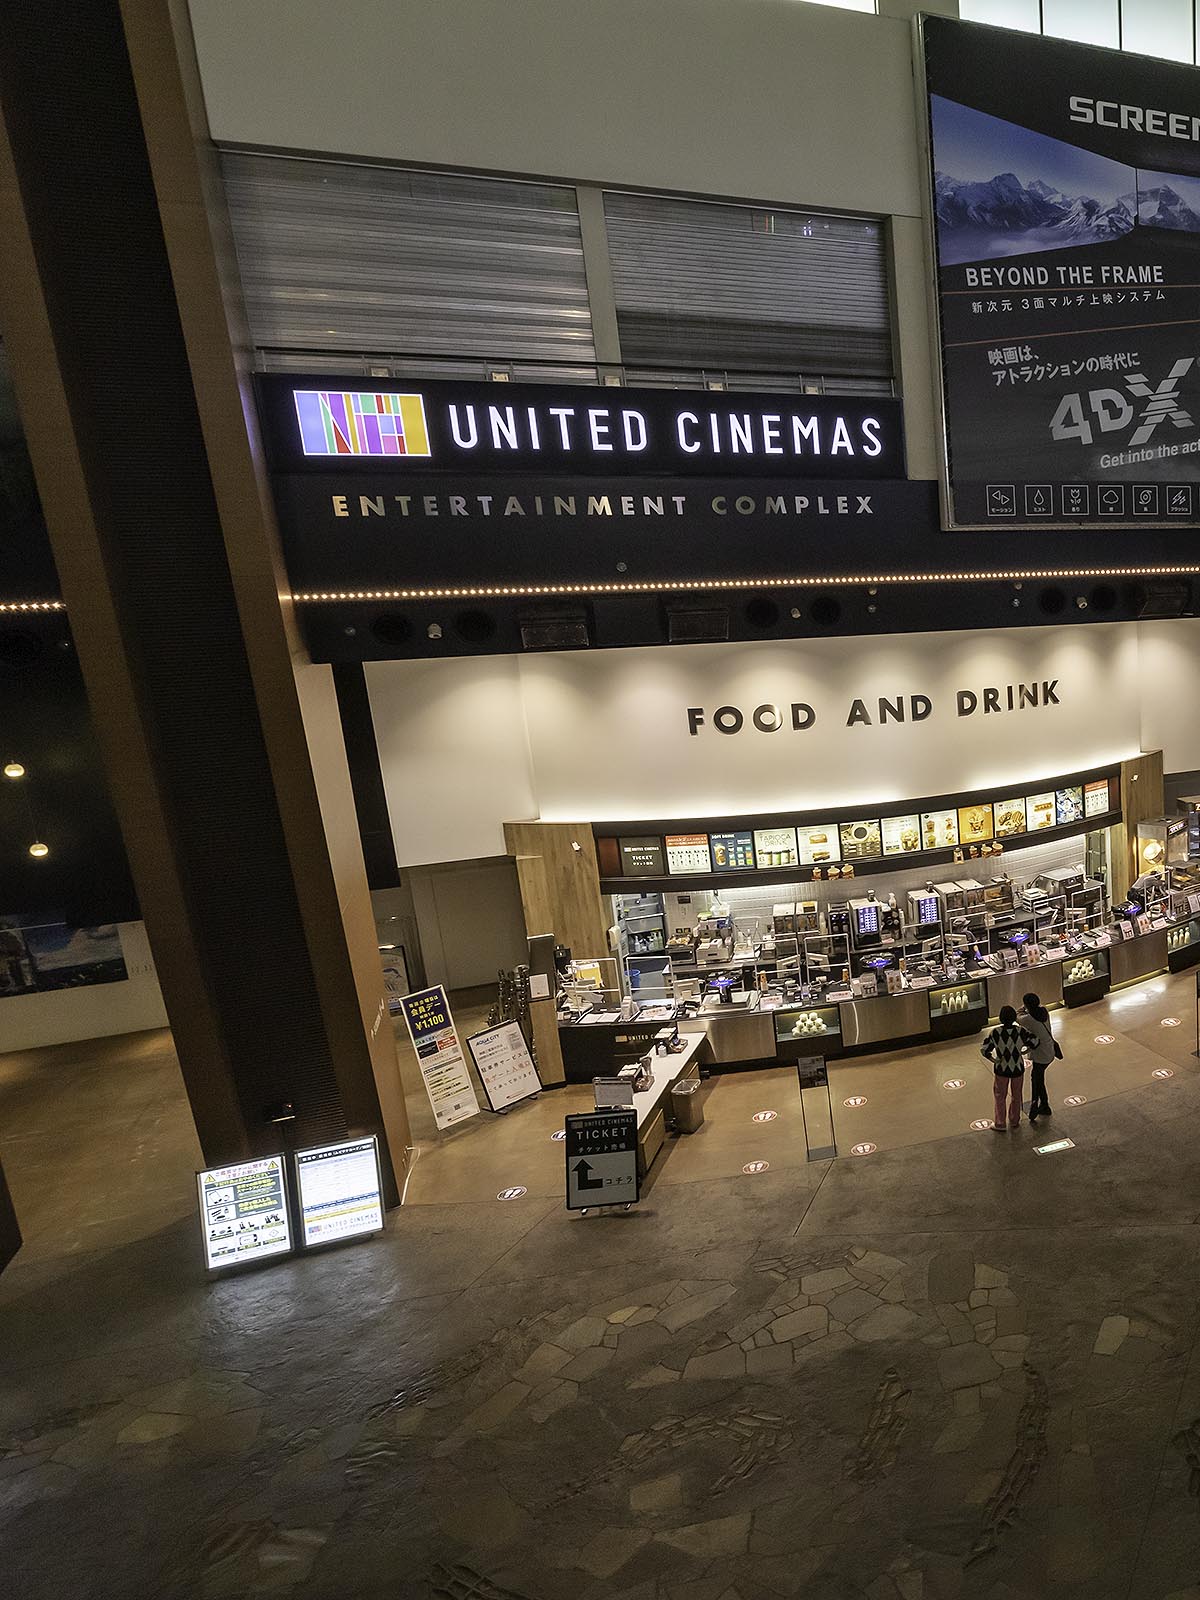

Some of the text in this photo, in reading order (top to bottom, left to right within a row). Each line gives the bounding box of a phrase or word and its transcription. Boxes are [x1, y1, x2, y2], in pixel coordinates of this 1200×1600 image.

[966, 265, 1164, 287] BEYOND THE FRAME
[972, 300, 1013, 314] 新次元
[988, 346, 1039, 366] 映画は、
[992, 352, 1140, 386] アトラクションの時代に
[1049, 357, 1195, 446] 4DX
[449, 404, 882, 457] UNITED CINEMAS
[1100, 452, 1125, 468] Get
[1128, 449, 1154, 464] into
[1157, 444, 1178, 457] the
[332, 495, 873, 517] ENTERTAINMENT COMPLEX
[687, 679, 1060, 736] FOOD AND DRINK
[759, 833, 791, 842] TAPIOCA
[577, 1127, 628, 1140] TICKET
[606, 1176, 633, 1185] コチラ
